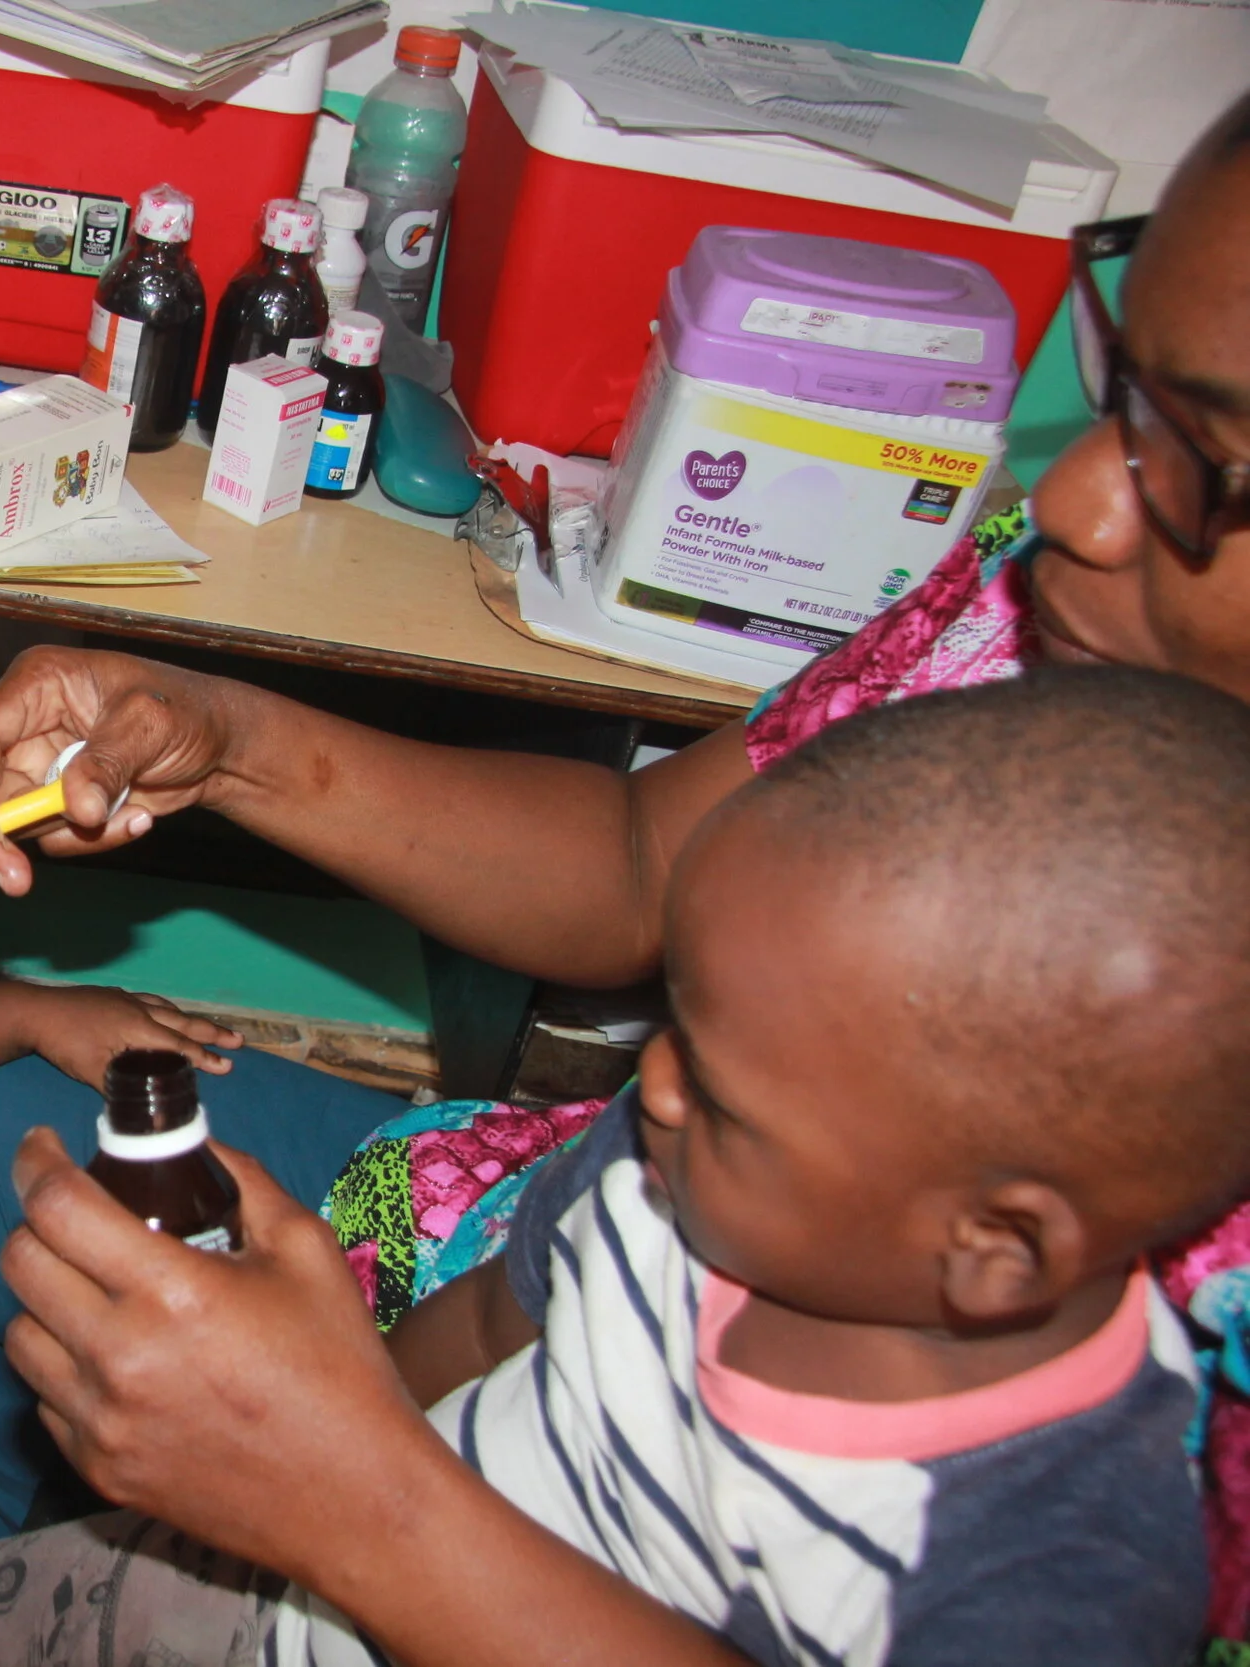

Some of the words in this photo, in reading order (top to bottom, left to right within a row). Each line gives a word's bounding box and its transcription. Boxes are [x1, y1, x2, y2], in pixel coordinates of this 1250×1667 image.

[85, 228, 112, 243] 13
[385, 209, 438, 269] G
[880, 443, 923, 464] 50%
[928, 453, 977, 474] More
[692, 460, 739, 478] Parent's
[85, 472, 99, 505] Baby
[696, 479, 730, 489] CHOICE
[922, 486, 950, 497] TRIPLE
[662, 537, 710, 558] Powder
[713, 551, 741, 567] With
[744, 559, 768, 573] Iron
[666, 525, 702, 543] Infant
[705, 536, 756, 556] Formula
[758, 548, 825, 572] Milk-based
[672, 577, 697, 587] Vitamins
[705, 584, 729, 595] Minerals
[883, 581, 903, 590] GMO
[886, 575, 906, 583] NON
[784, 598, 798, 609] NET
[798, 601, 810, 612] WT
[809, 603, 823, 615] 33.2
[823, 607, 833, 617] OZ
[832, 608, 851, 620] (2.07
[850, 611, 862, 624] LB)
[742, 626, 772, 638] ENFAMIL
[793, 627, 806, 635] THE
